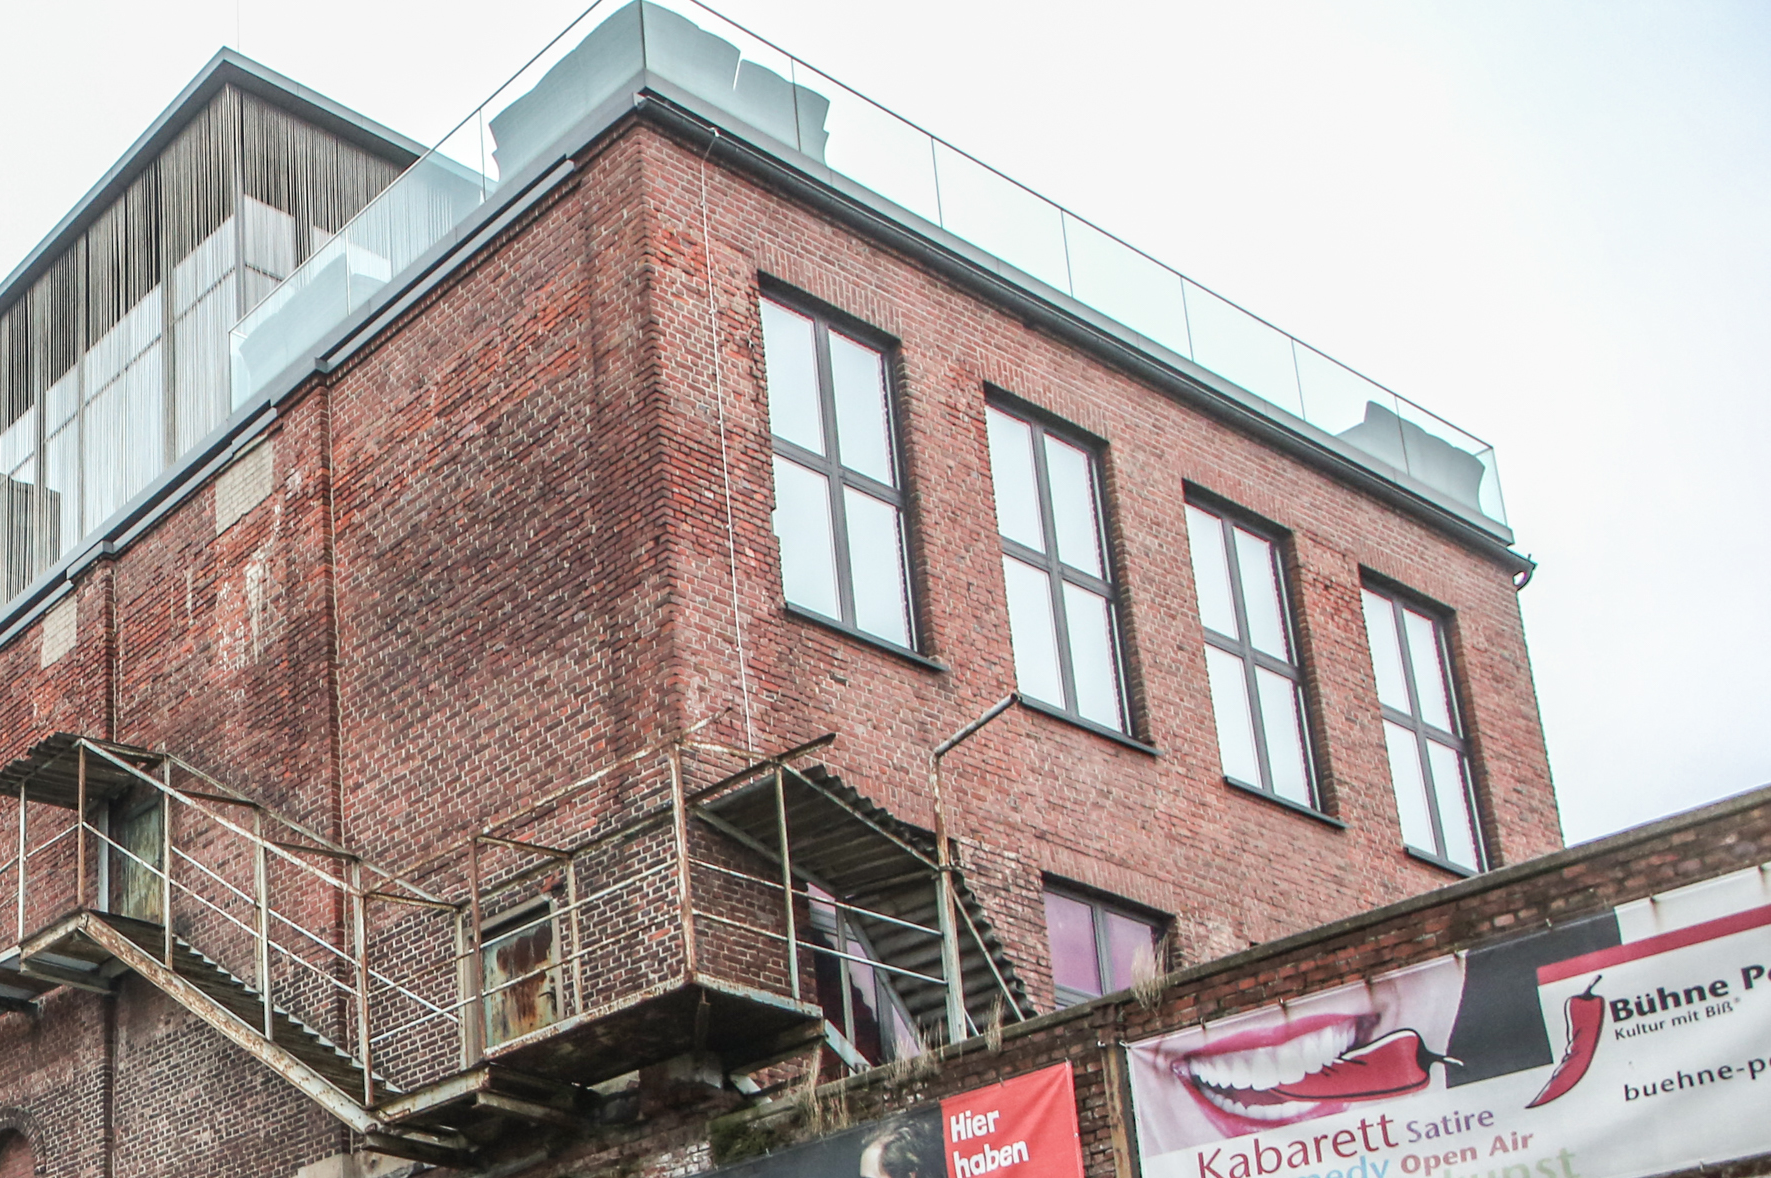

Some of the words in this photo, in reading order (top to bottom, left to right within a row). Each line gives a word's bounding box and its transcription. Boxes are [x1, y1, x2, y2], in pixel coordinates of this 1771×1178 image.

[1609, 979, 1729, 1023] Bühne
[1740, 964, 1771, 991] P
[1614, 1019, 1665, 1041] Kultur
[1671, 1010, 1700, 1027] mit
[1624, 1056, 1771, 1102] buehne-p
[950, 1110, 1000, 1143] Hier
[1406, 1109, 1495, 1143] Satire
[1400, 1142, 1478, 1176] Open
[1488, 1130, 1534, 1156] Air
